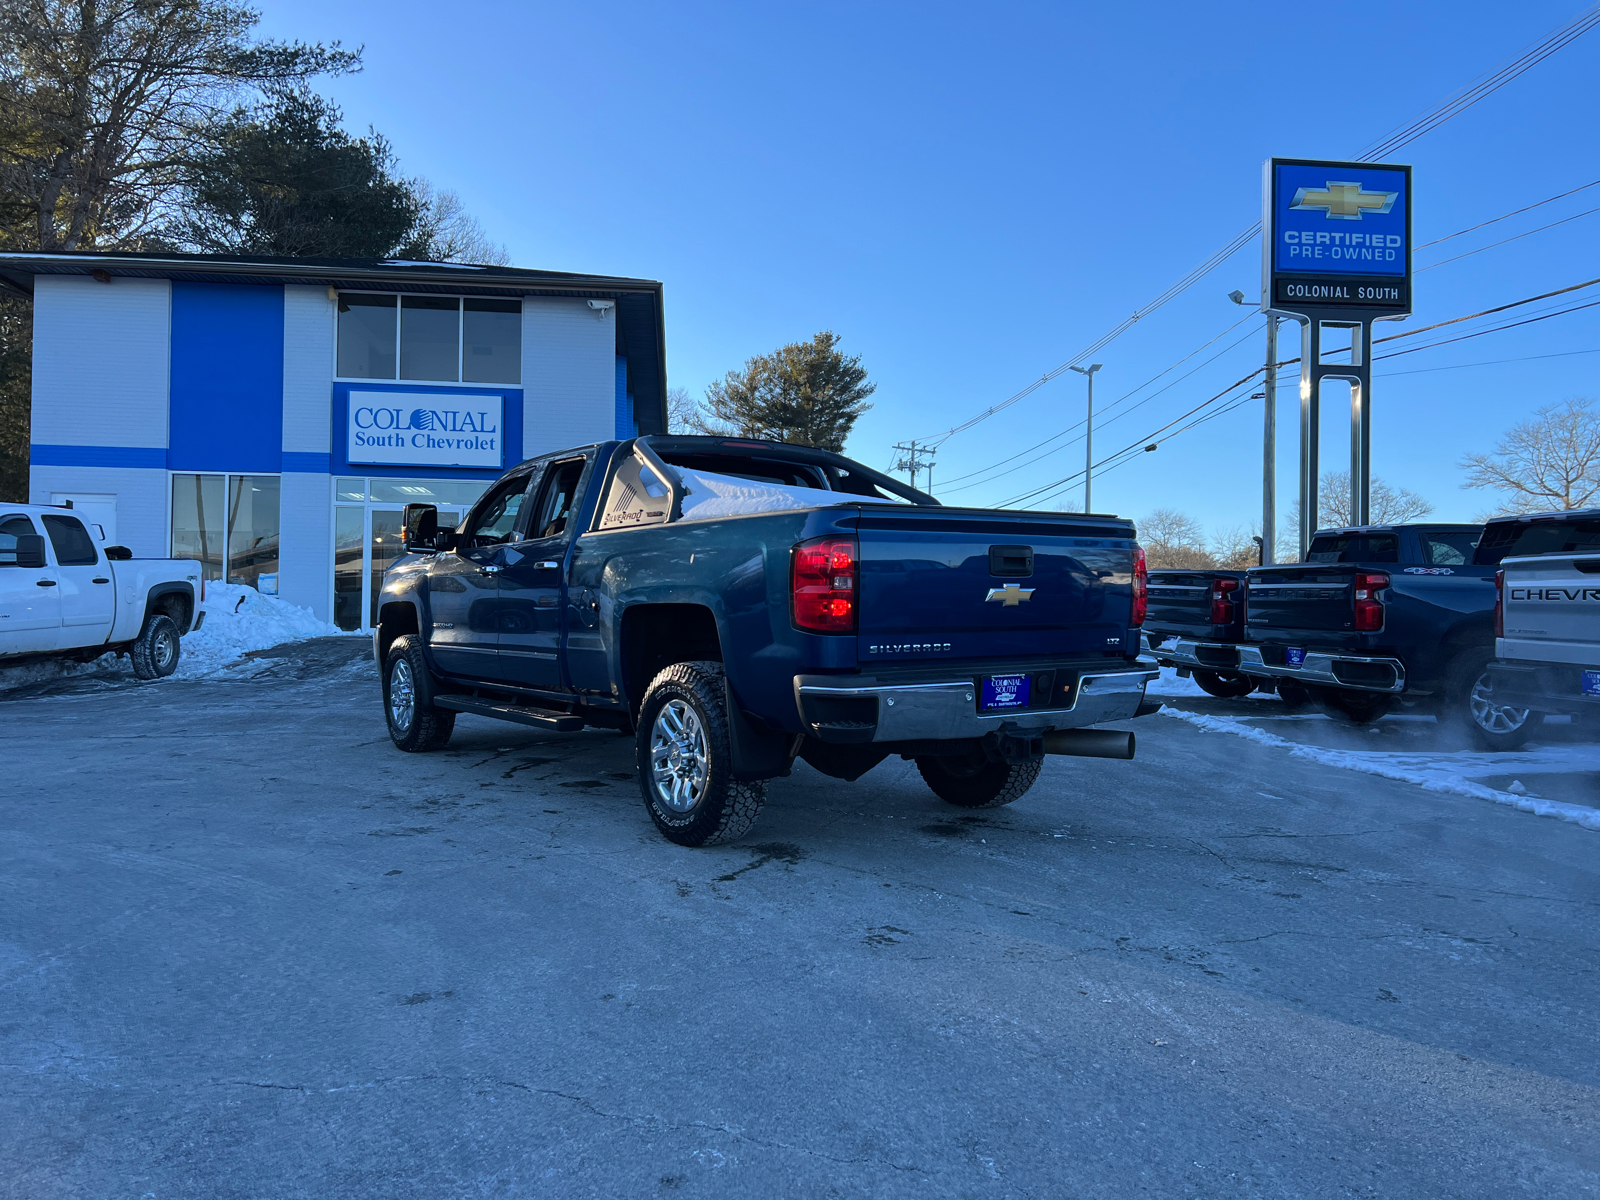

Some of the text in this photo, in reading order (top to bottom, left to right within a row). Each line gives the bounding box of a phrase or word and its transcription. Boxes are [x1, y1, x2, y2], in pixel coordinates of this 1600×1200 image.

[1284, 230, 1402, 248] CERTIFIED
[1290, 245, 1396, 261] PRE-OWNED
[1287, 284, 1398, 300] COLONIAL SOUTH
[354, 407, 496, 433] COLONIAL
[355, 431, 496, 451] South Chevrolet
[605, 512, 642, 523] SILVERADO
[869, 643, 951, 654] SILVERADO
